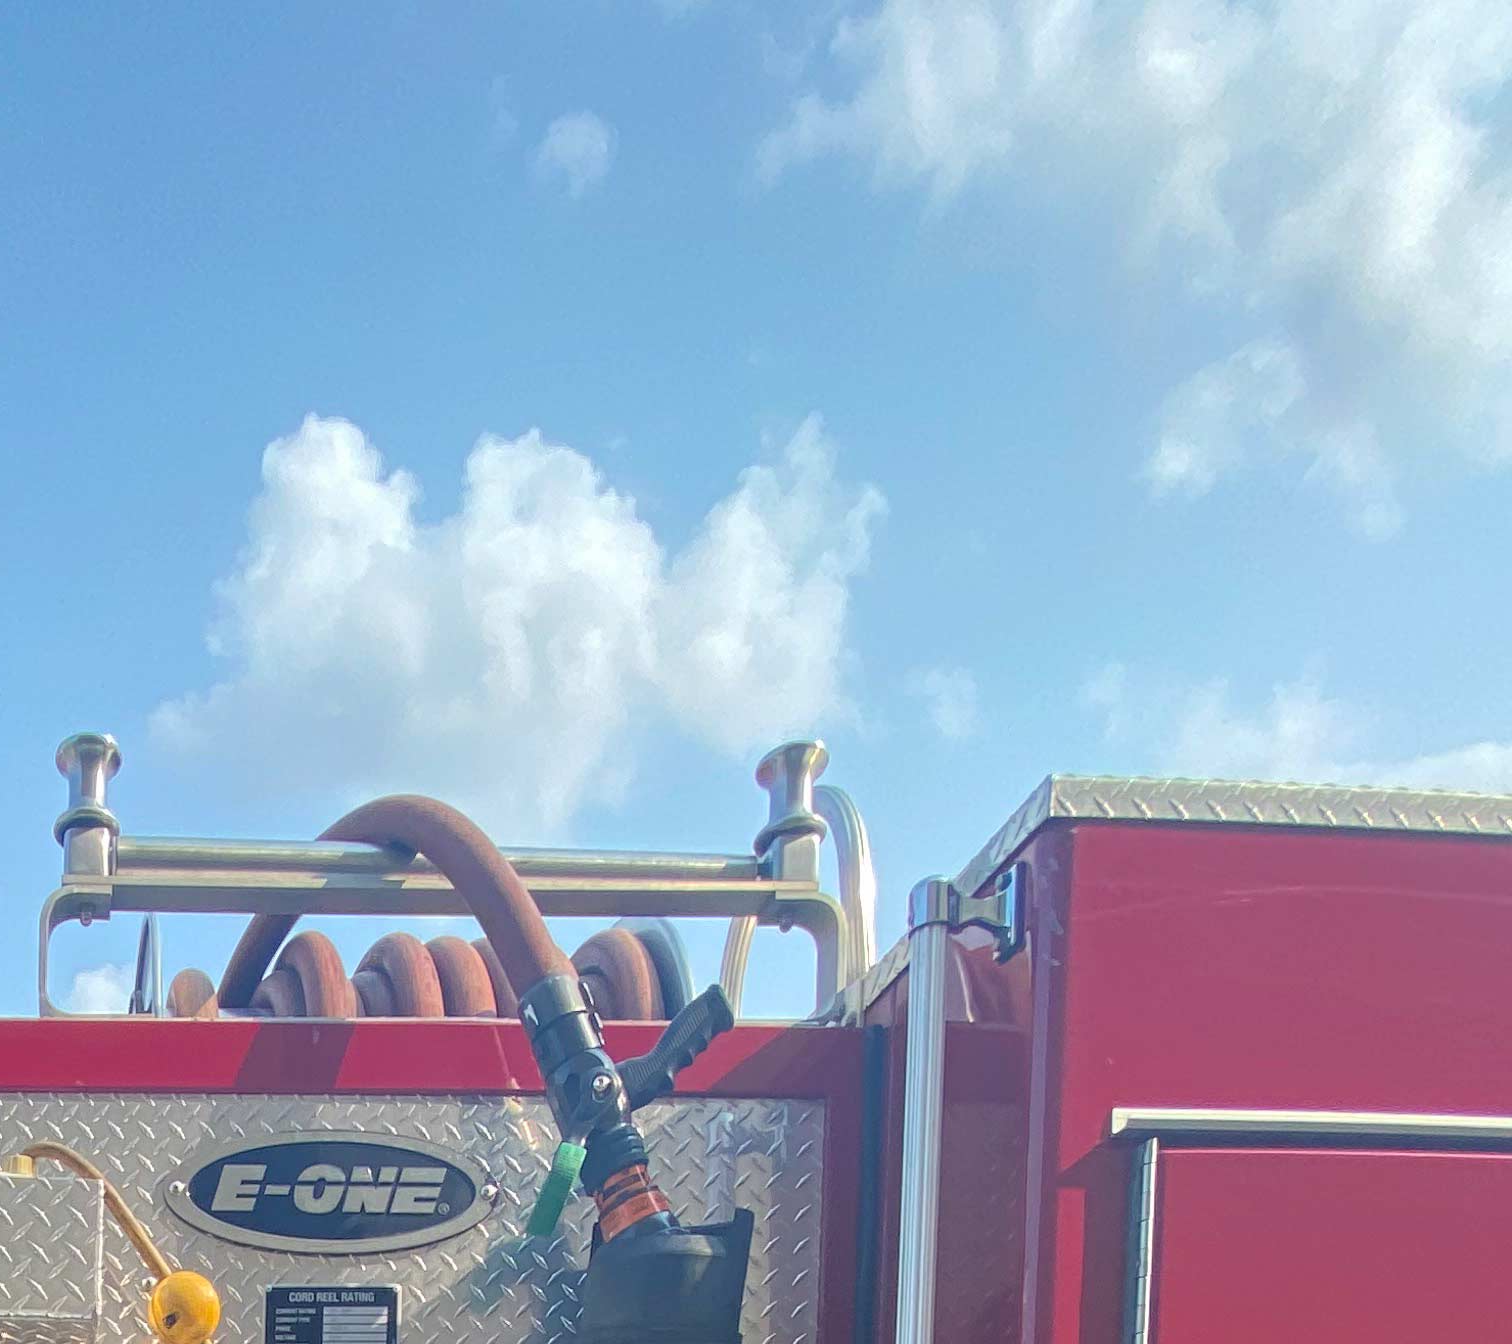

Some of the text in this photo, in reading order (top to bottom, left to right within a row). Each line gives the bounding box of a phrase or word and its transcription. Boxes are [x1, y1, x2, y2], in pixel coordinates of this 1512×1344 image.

[211, 1163, 448, 1214] E-ONE
[288, 1291, 375, 1303] CORD REEL RATING
